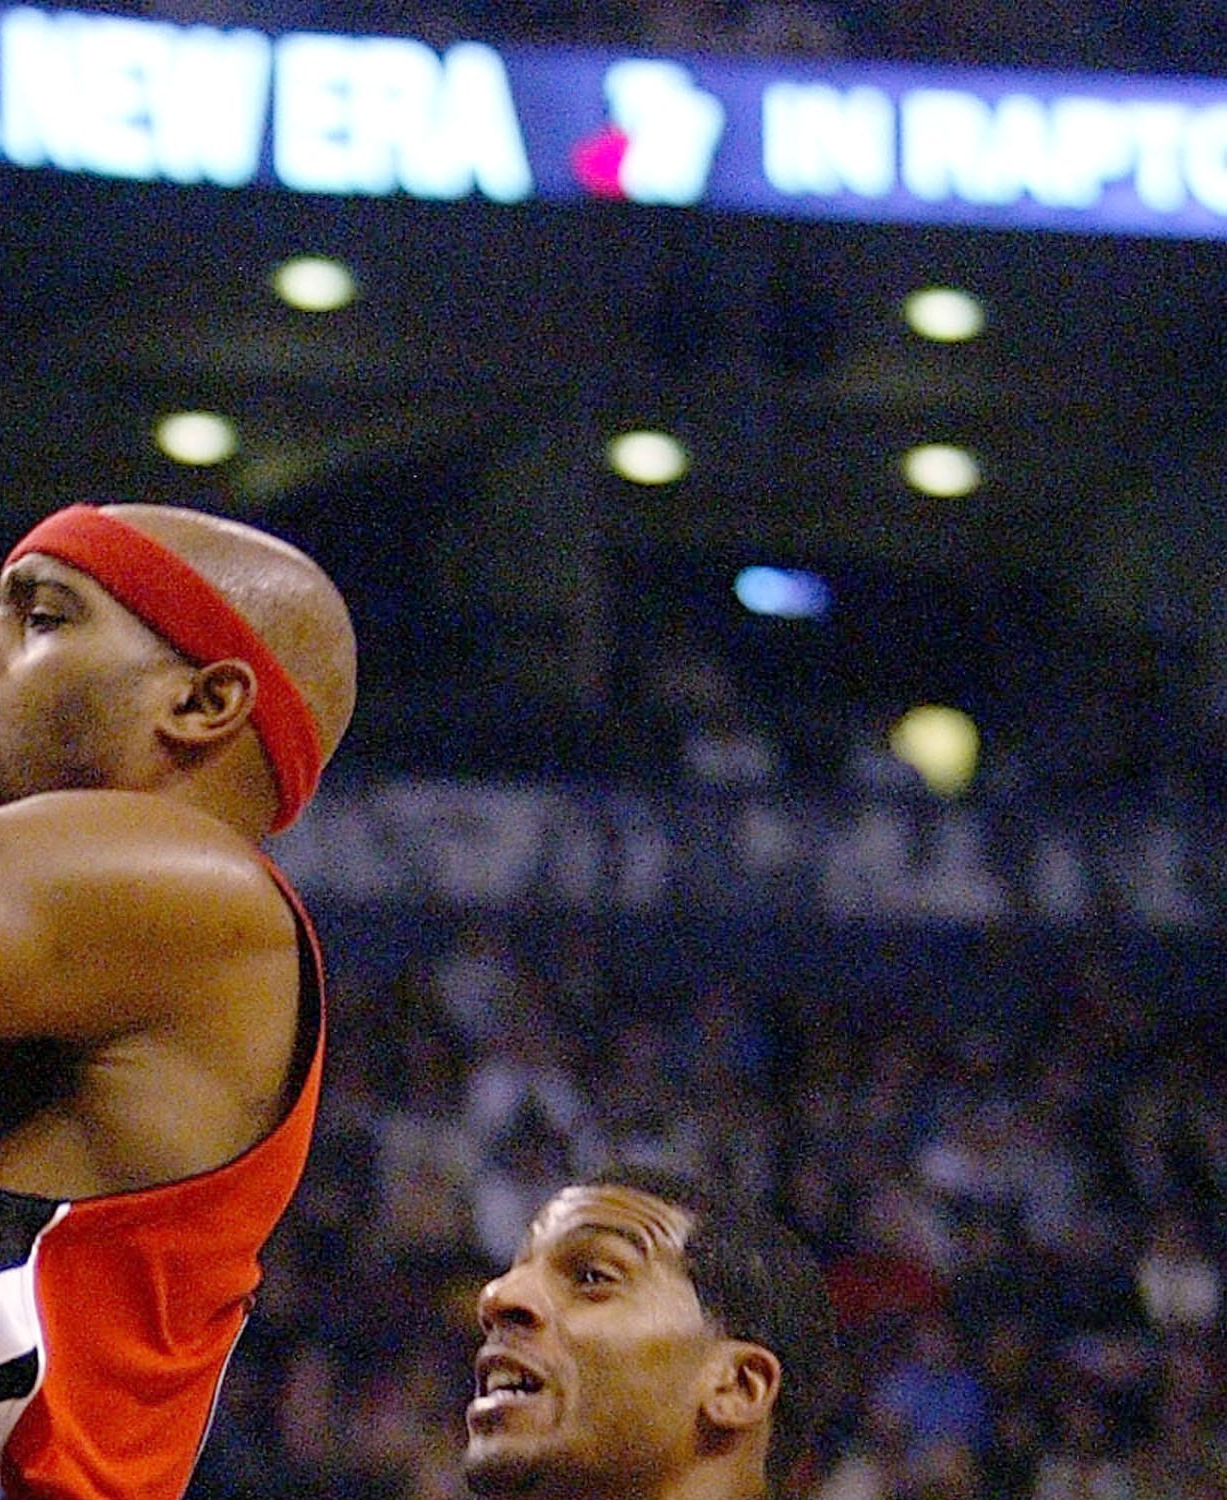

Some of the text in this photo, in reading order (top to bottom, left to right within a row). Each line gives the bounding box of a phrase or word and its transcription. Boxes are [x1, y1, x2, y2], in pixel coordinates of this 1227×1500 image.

[2, 5, 272, 188] NEW
[274, 31, 533, 202] ERA
[763, 82, 896, 197] IN
